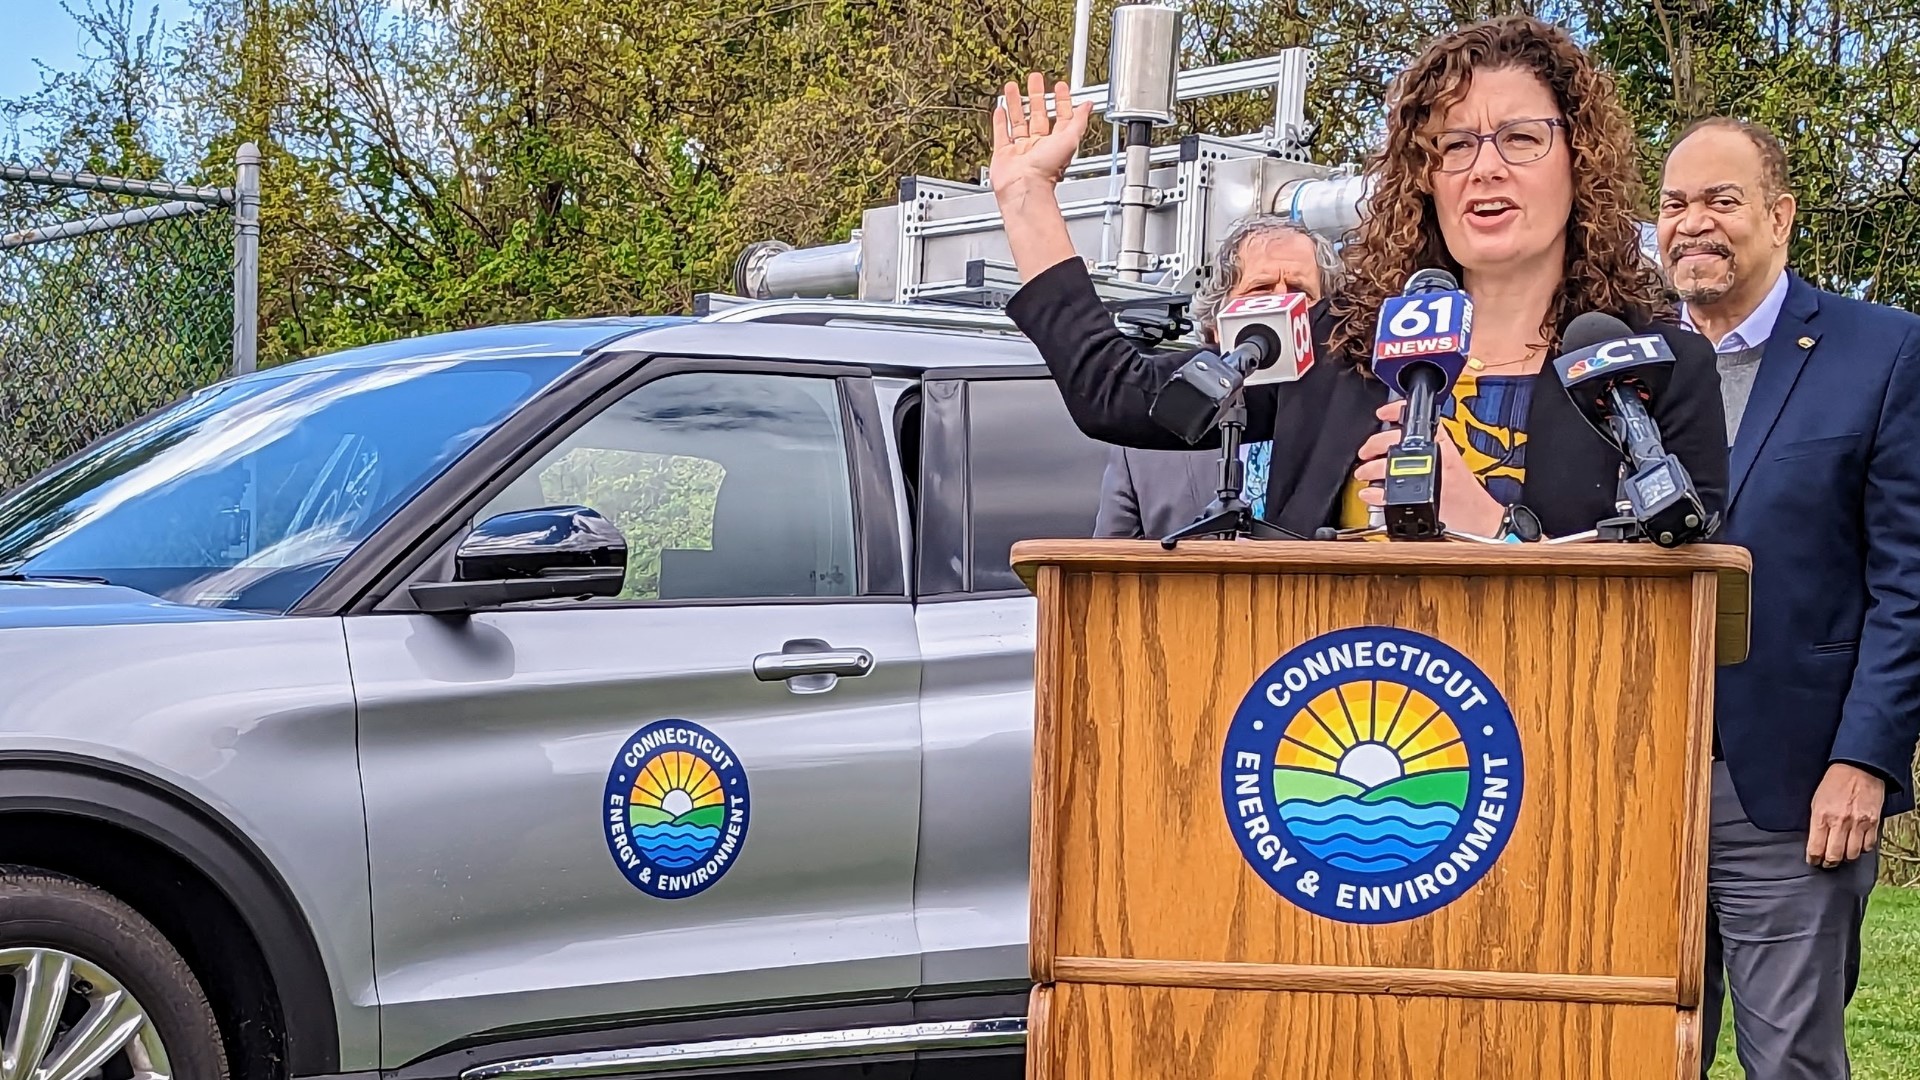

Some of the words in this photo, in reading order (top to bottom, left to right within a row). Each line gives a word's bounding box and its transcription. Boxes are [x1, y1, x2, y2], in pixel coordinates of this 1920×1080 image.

[1293, 313, 1310, 362] 8
[1389, 297, 1453, 337] 61
[1384, 336, 1453, 356] NEWS
[1596, 336, 1660, 363] CT
[1266, 641, 1488, 711] CONNECTICUT
[624, 727, 734, 770] CONNECTICUT
[610, 794, 641, 869] ENERGY
[638, 867, 651, 884] &
[657, 794, 744, 891] ENVIRONMENT
[1235, 751, 1297, 873] ENERGY
[1296, 870, 1320, 898] &
[1336, 753, 1509, 911] ENVIRONMENT
